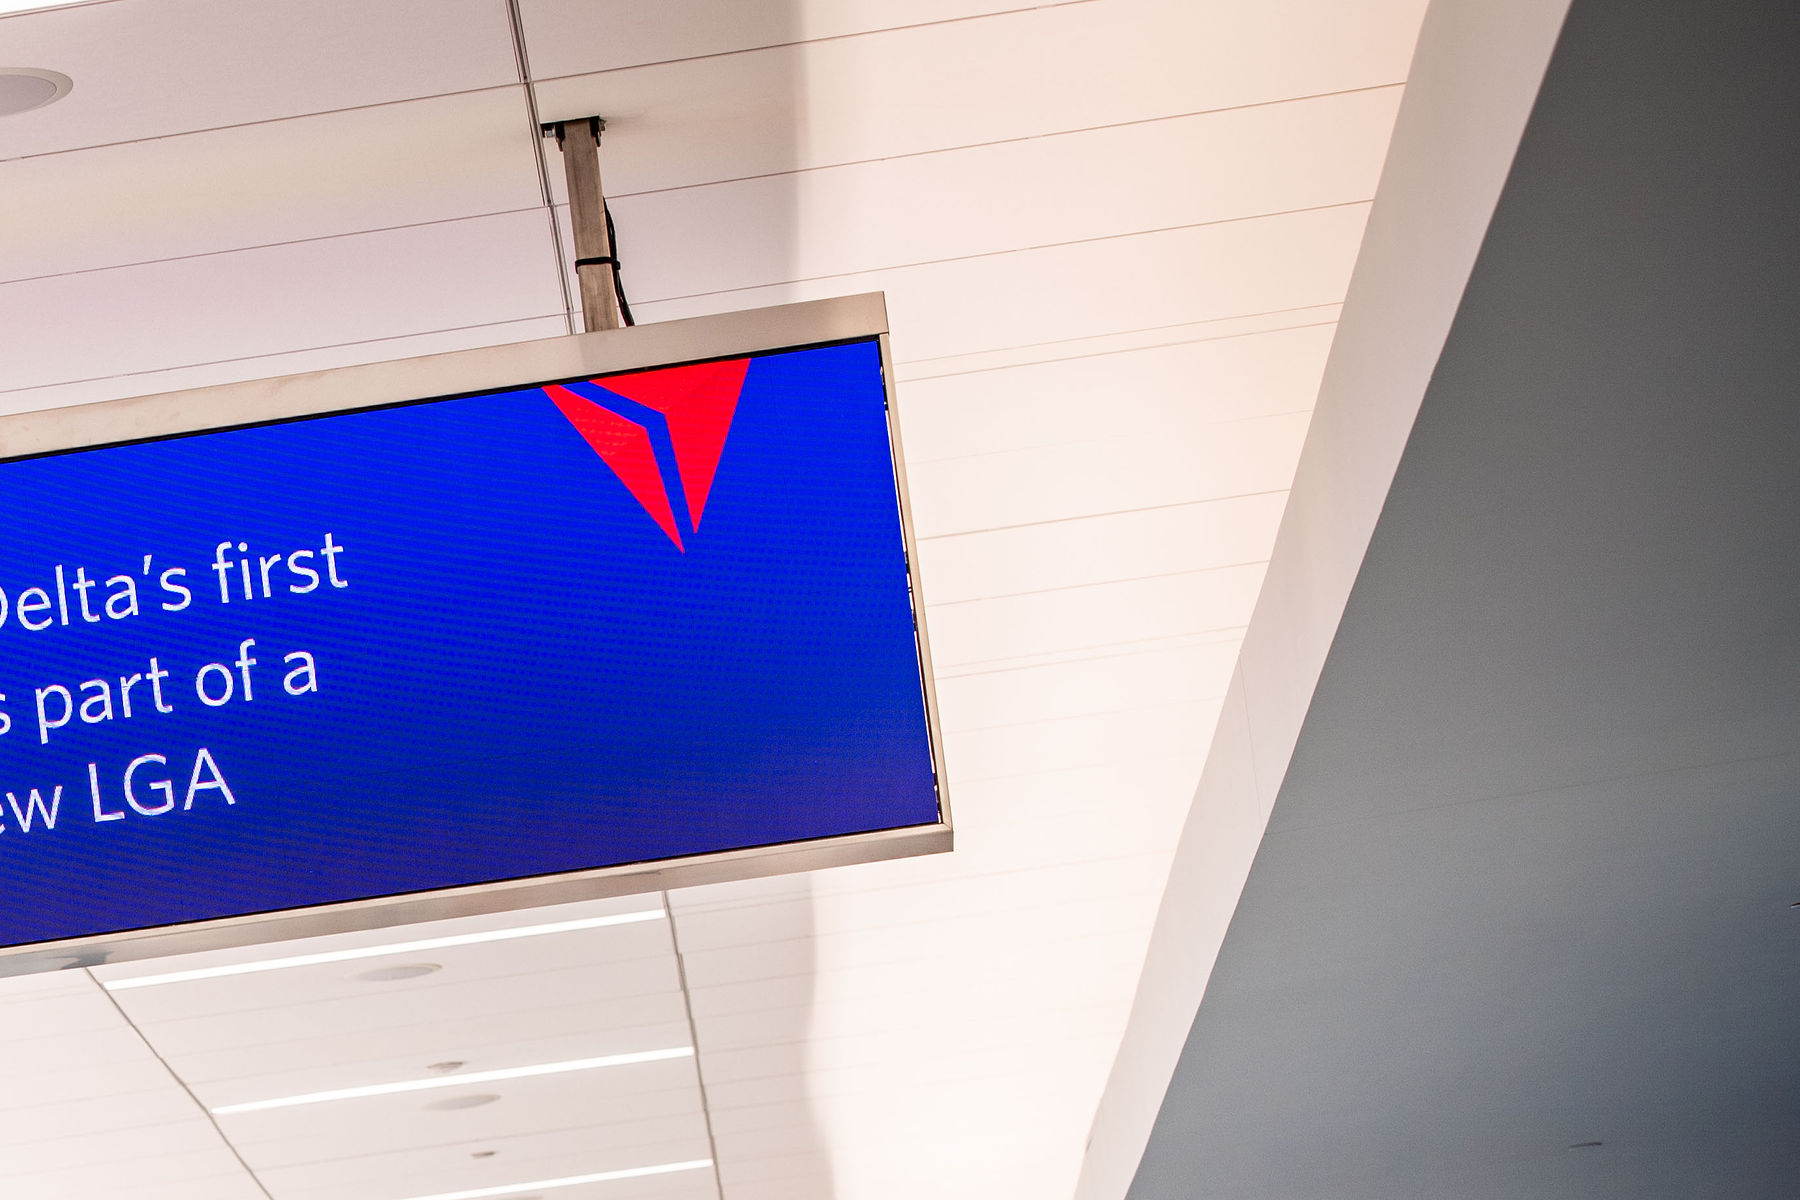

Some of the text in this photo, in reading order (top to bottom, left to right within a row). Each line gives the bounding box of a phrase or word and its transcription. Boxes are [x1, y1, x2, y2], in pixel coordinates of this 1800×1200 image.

[211, 532, 349, 604] first
[35, 657, 174, 745] part
[195, 638, 257, 707] of
[283, 651, 318, 696] a
[88, 748, 236, 823] LGA
